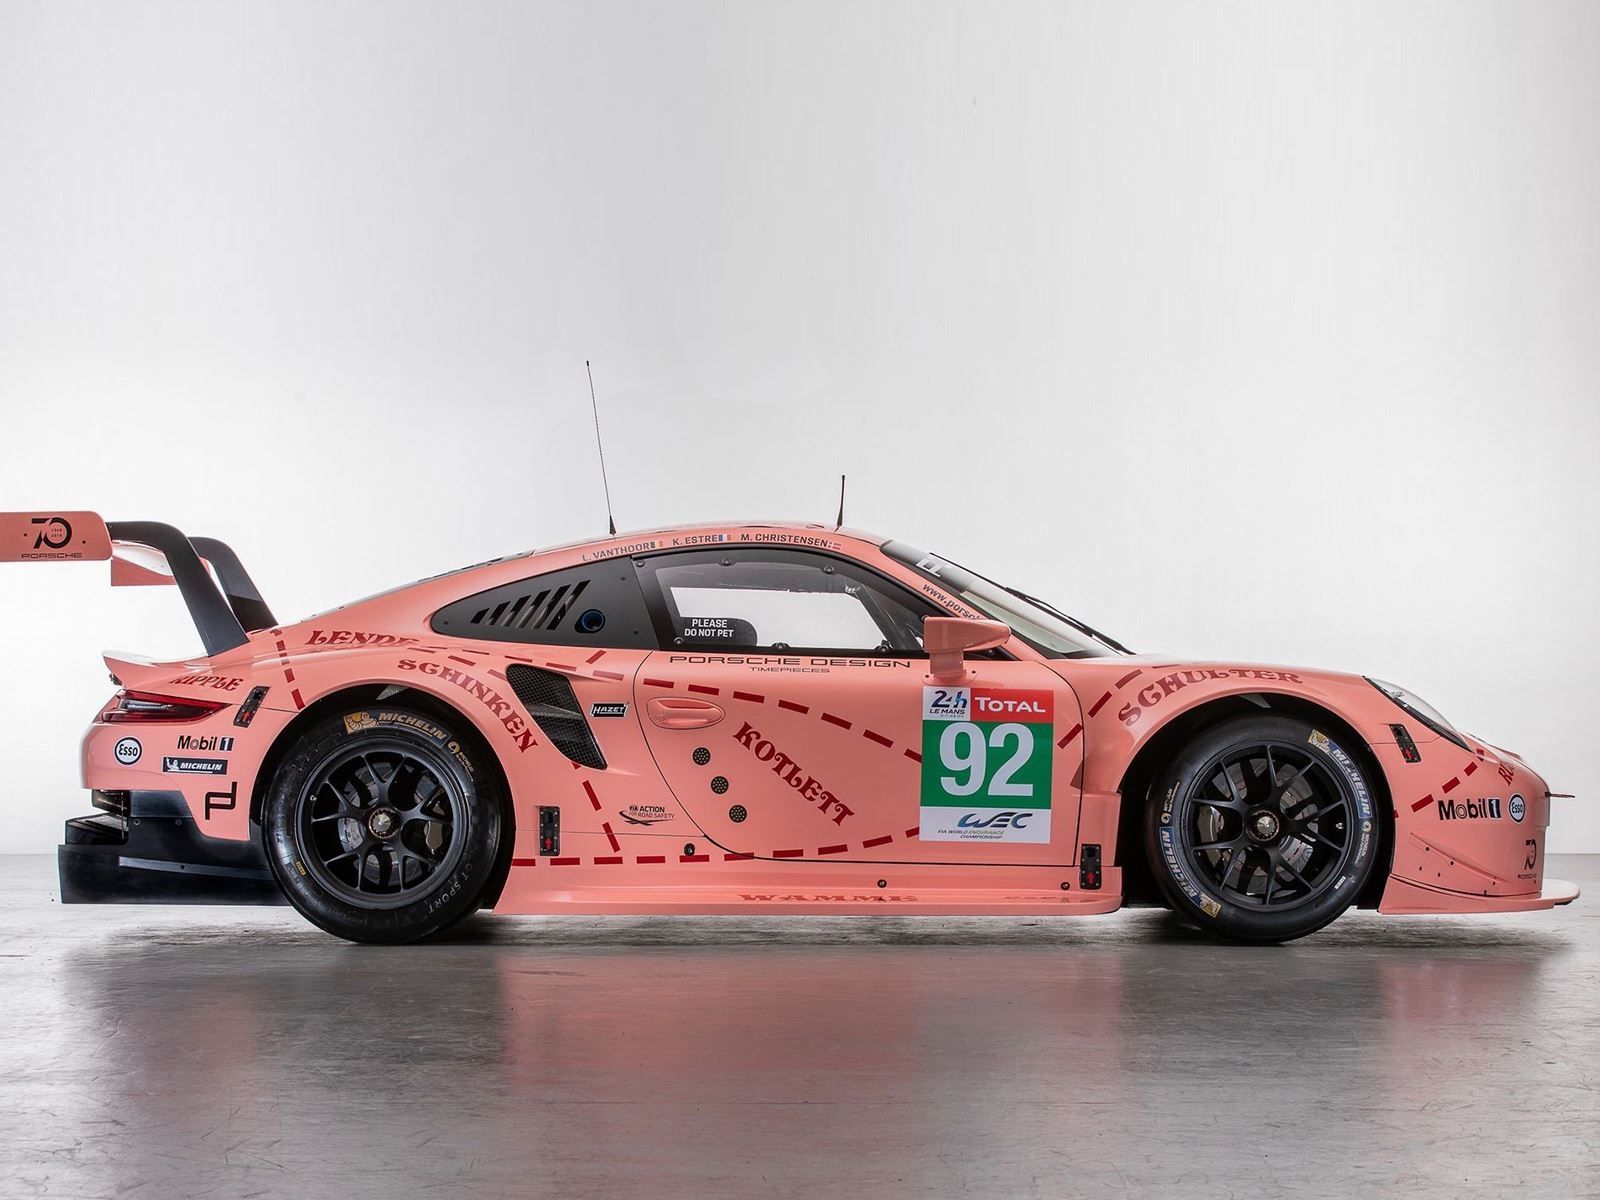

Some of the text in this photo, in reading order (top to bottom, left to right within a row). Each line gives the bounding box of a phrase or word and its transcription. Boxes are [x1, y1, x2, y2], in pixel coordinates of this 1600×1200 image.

[31, 516, 72, 549] 70
[673, 534, 718, 546] K. ESTRE
[740, 533, 829, 548] M. CHRISTENSEN
[582, 541, 650, 562] L. VANTHOOR
[692, 618, 728, 628] PLEASE
[304, 630, 419, 645] LENDE
[684, 628, 734, 638] DO NOT PET
[669, 656, 911, 668] PORSCHE DESIGN
[1118, 668, 1304, 727] SCHULTER
[397, 659, 538, 753] SCHINKEN
[592, 705, 625, 715] HAZET
[377, 711, 448, 740] MICHELIN
[118, 743, 138, 757] Esso
[177, 735, 219, 751] Mobil
[180, 762, 223, 771] MICHELIN
[939, 721, 1035, 797] 92
[732, 721, 855, 826] KOTLETT
[1438, 798, 1487, 820] Mobil
[1511, 802, 1523, 814] Esso
[957, 811, 1033, 829] WEC
[1162, 830, 1198, 898] MICHELIN
[429, 881, 461, 914] SPORT
[738, 894, 918, 903] WAMME
